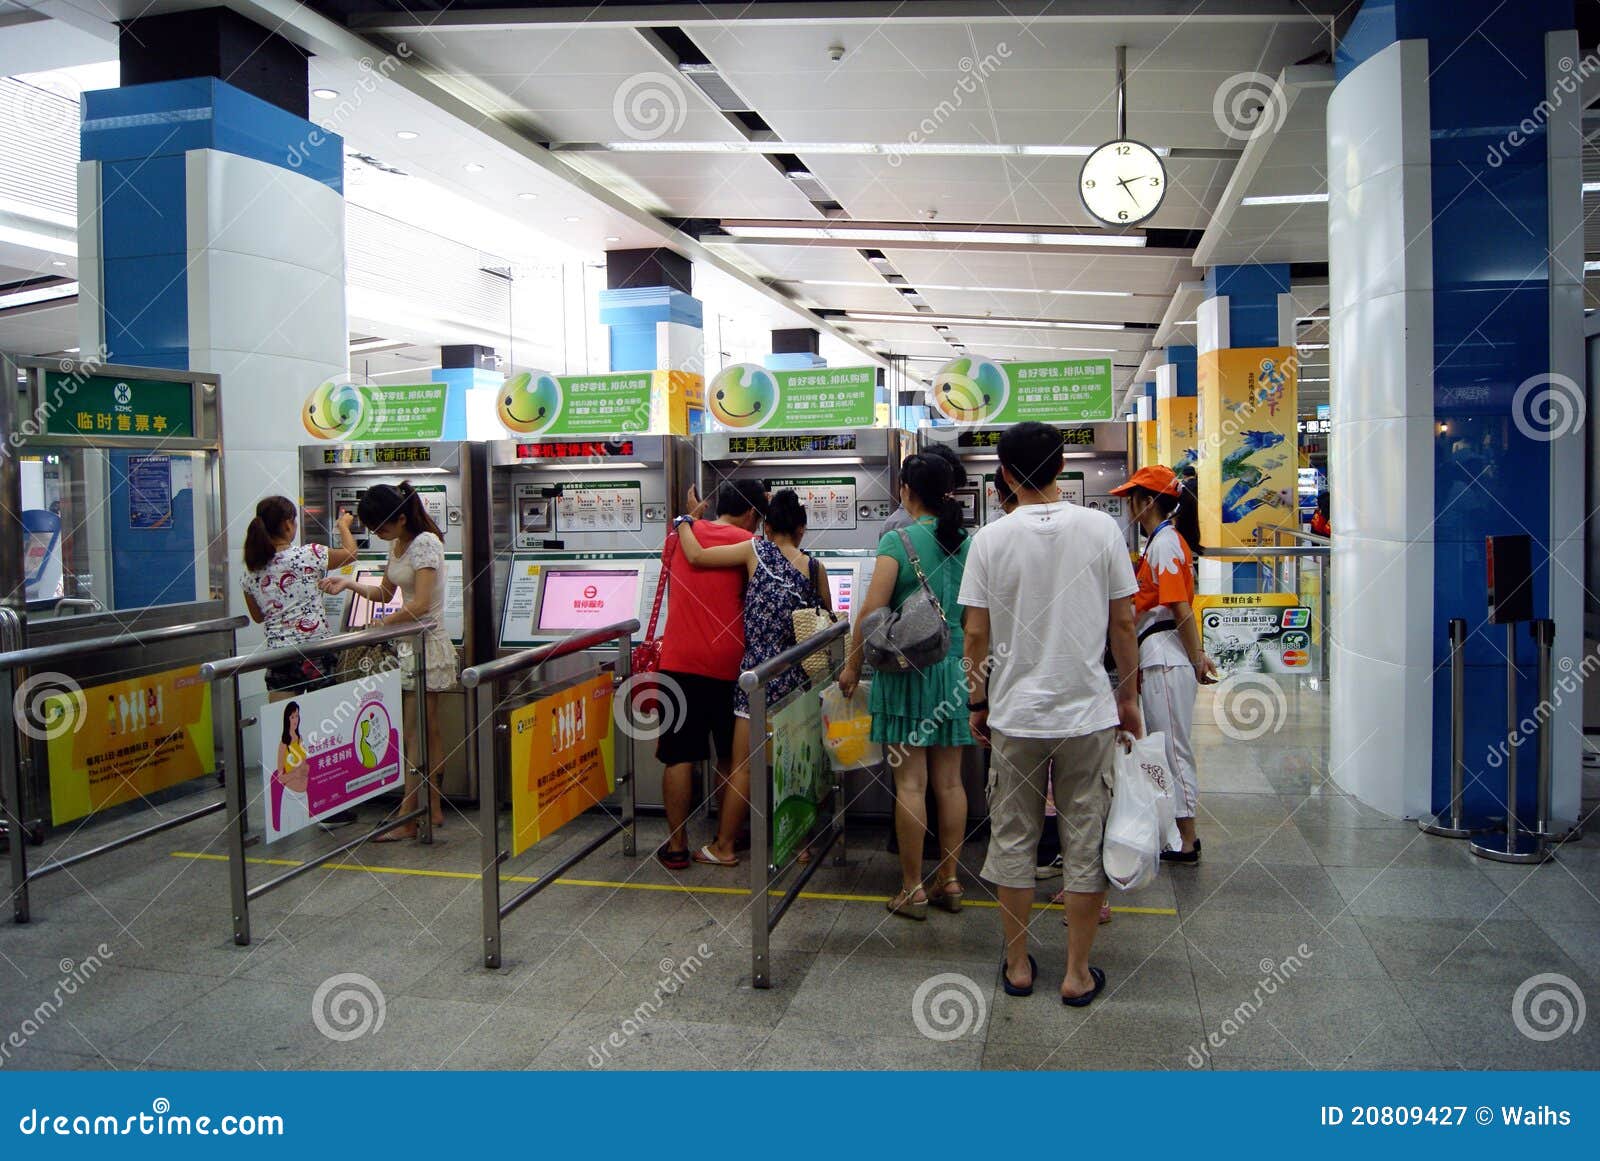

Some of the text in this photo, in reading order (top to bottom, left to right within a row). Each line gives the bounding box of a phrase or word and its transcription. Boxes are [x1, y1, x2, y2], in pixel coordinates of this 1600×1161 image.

[1115, 145, 1130, 155] 12
[1085, 179, 1096, 189] 9
[1149, 177, 1160, 187] 3
[1117, 210, 1129, 220] 6
[77, 411, 168, 433] 临时售票亭
[573, 600, 605, 610] 暂停服务
[1222, 596, 1262, 604] 理财白金卡
[1222, 615, 1276, 623] 中国建设银行
